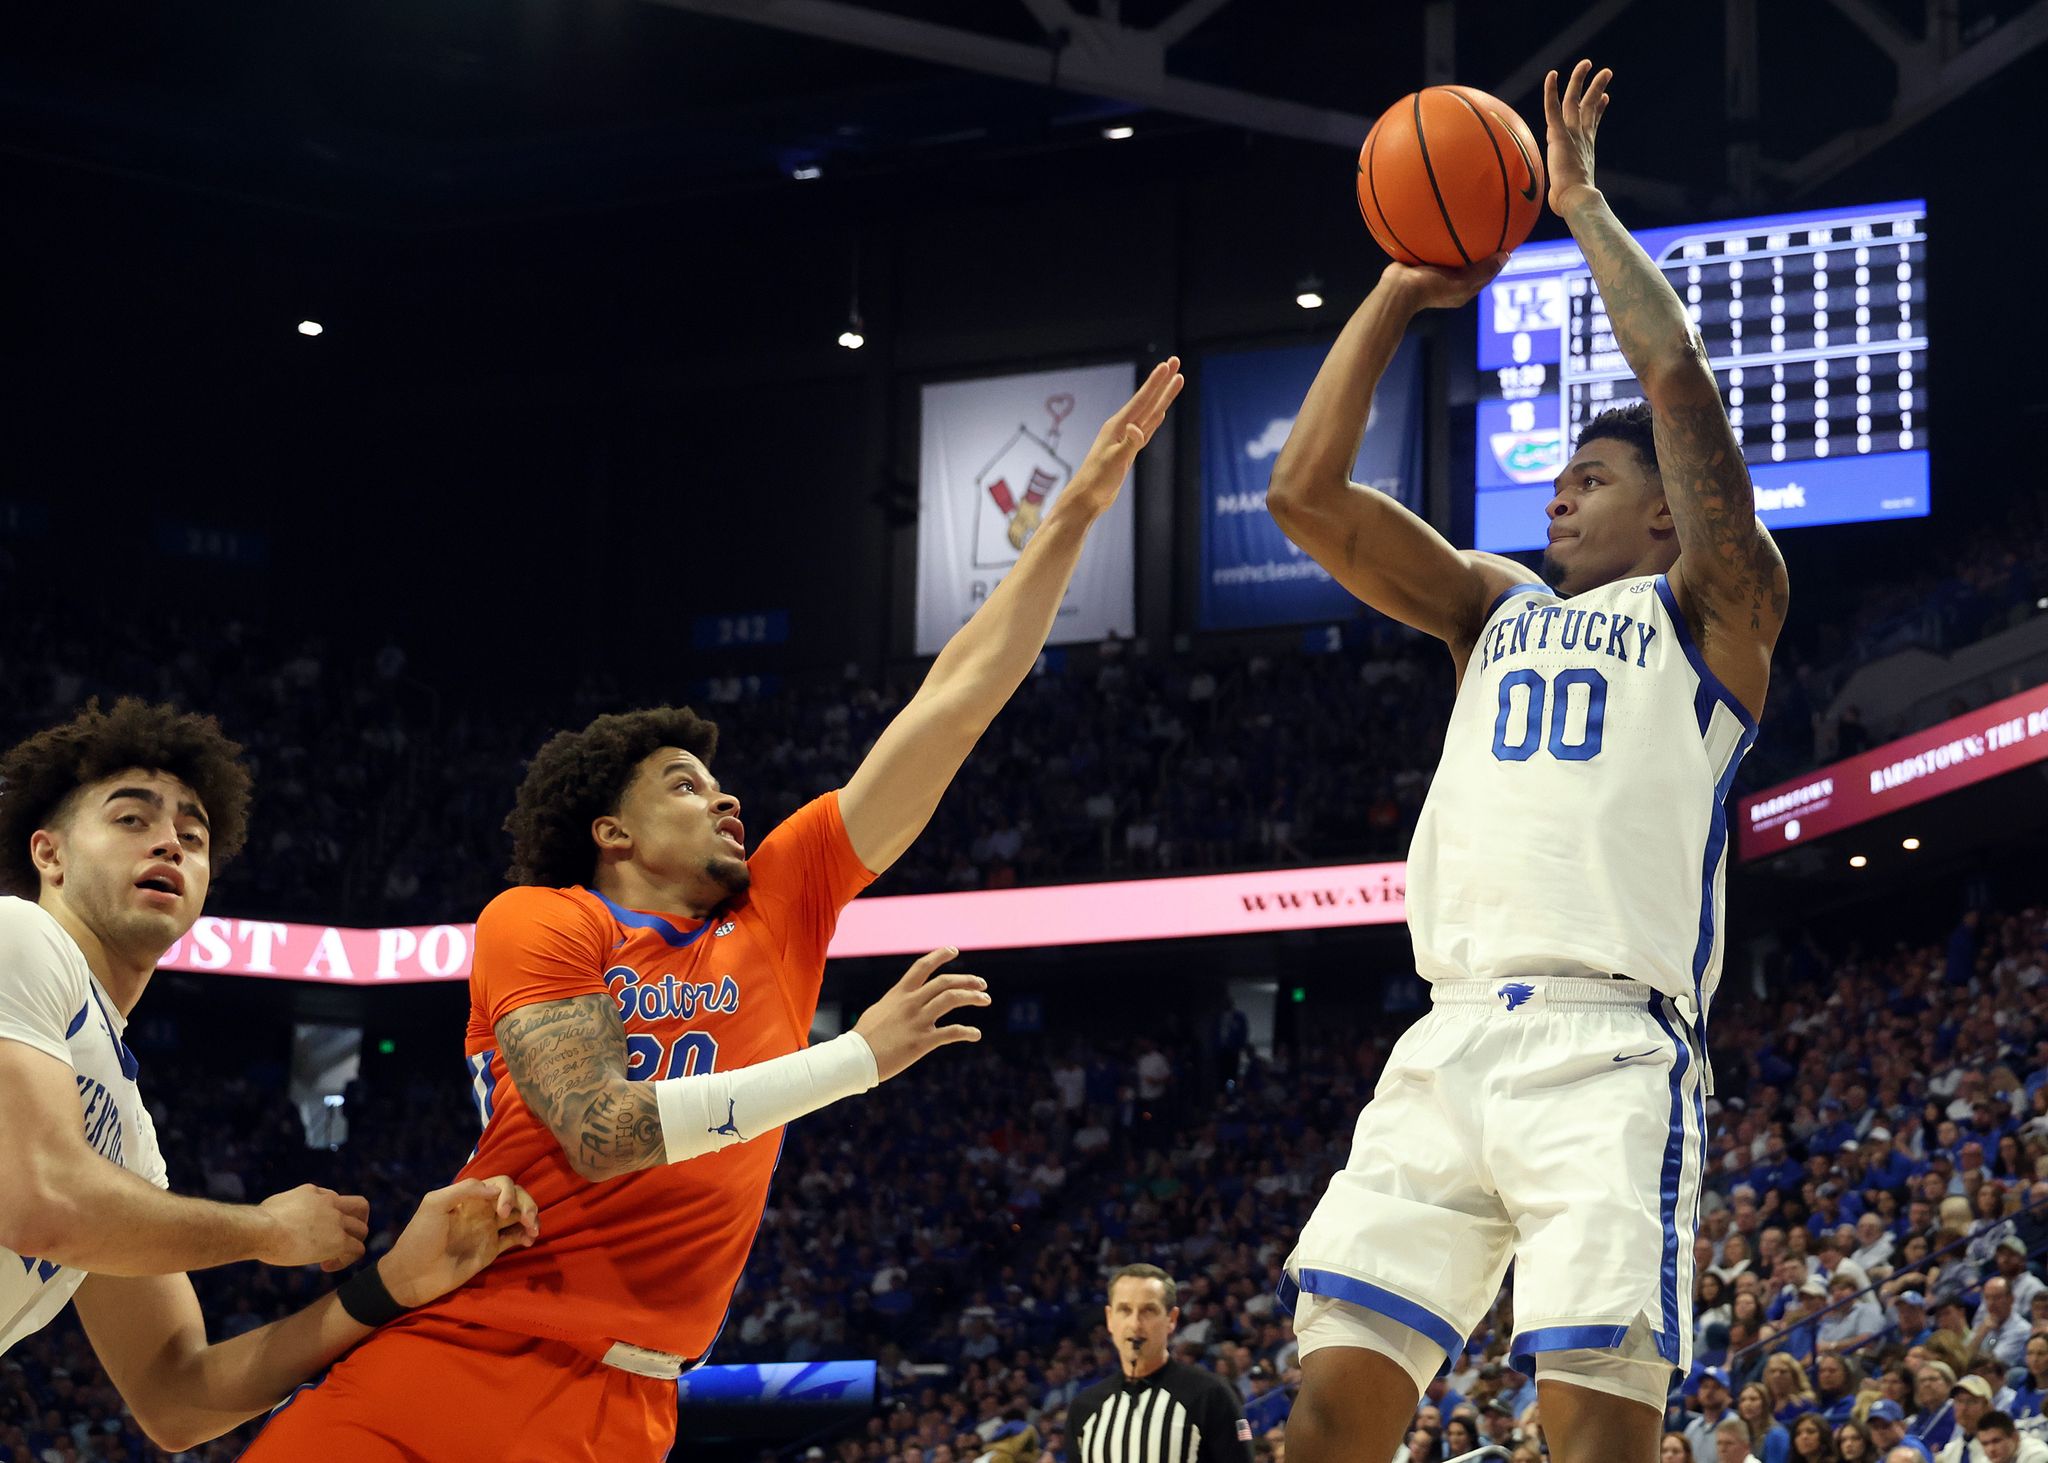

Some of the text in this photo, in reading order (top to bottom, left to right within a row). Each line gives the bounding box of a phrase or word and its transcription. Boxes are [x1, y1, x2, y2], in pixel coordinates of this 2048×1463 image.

[1491, 668, 1608, 762] 00
[303, 927, 354, 979] A
[375, 924, 476, 980] PO
[714, 921, 736, 937] SEC
[603, 965, 739, 1024] Gators
[626, 1031, 719, 1082] 20
[580, 1091, 616, 1171] FAITH
